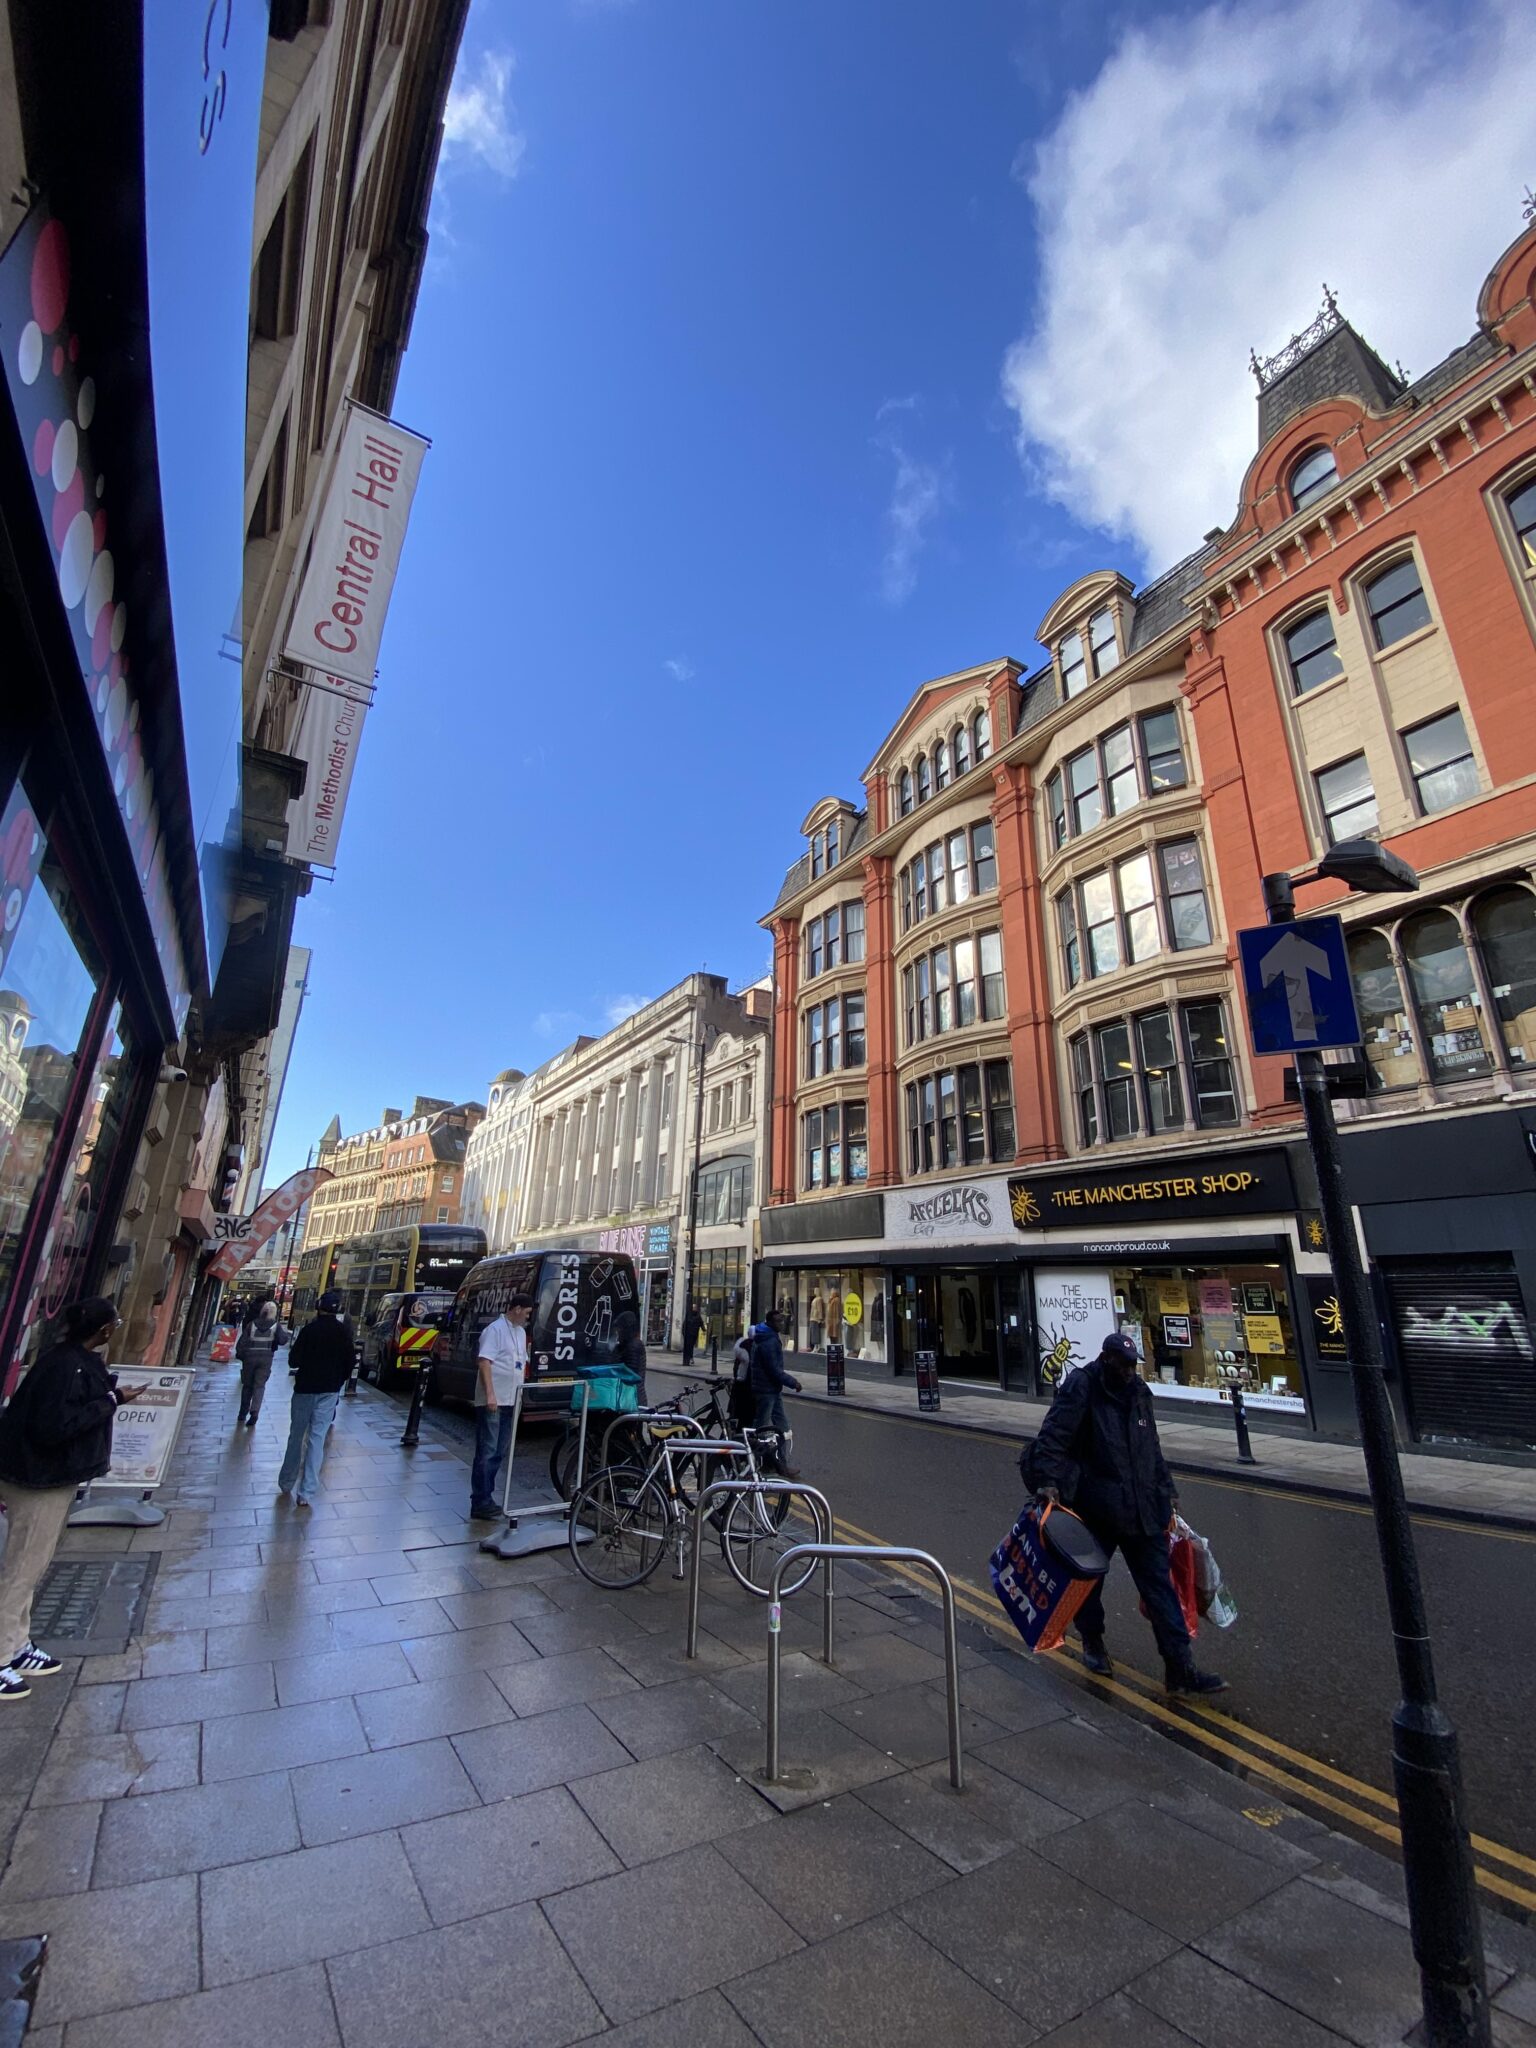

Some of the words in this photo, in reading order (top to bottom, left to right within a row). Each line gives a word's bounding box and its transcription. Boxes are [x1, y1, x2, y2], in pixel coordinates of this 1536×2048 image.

[314, 519, 383, 654] Central
[351, 434, 404, 510] Hall
[314, 738, 349, 821] Methodist
[306, 824, 330, 853] The
[1053, 1189, 1083, 1207] THE
[1084, 1177, 1198, 1205] MANCHESTER
[1201, 1171, 1252, 1195] SHOP
[909, 1186, 992, 1228] AFFLECKS
[211, 1173, 316, 1274] TATTOO
[1040, 1297, 1109, 1310] MANCHESTER
[1062, 1284, 1081, 1297] THE
[554, 1253, 581, 1361] STORES
[1062, 1310, 1088, 1322] SHOP
[117, 1410, 157, 1423] OPEN
[1038, 1568, 1057, 1594] BE
